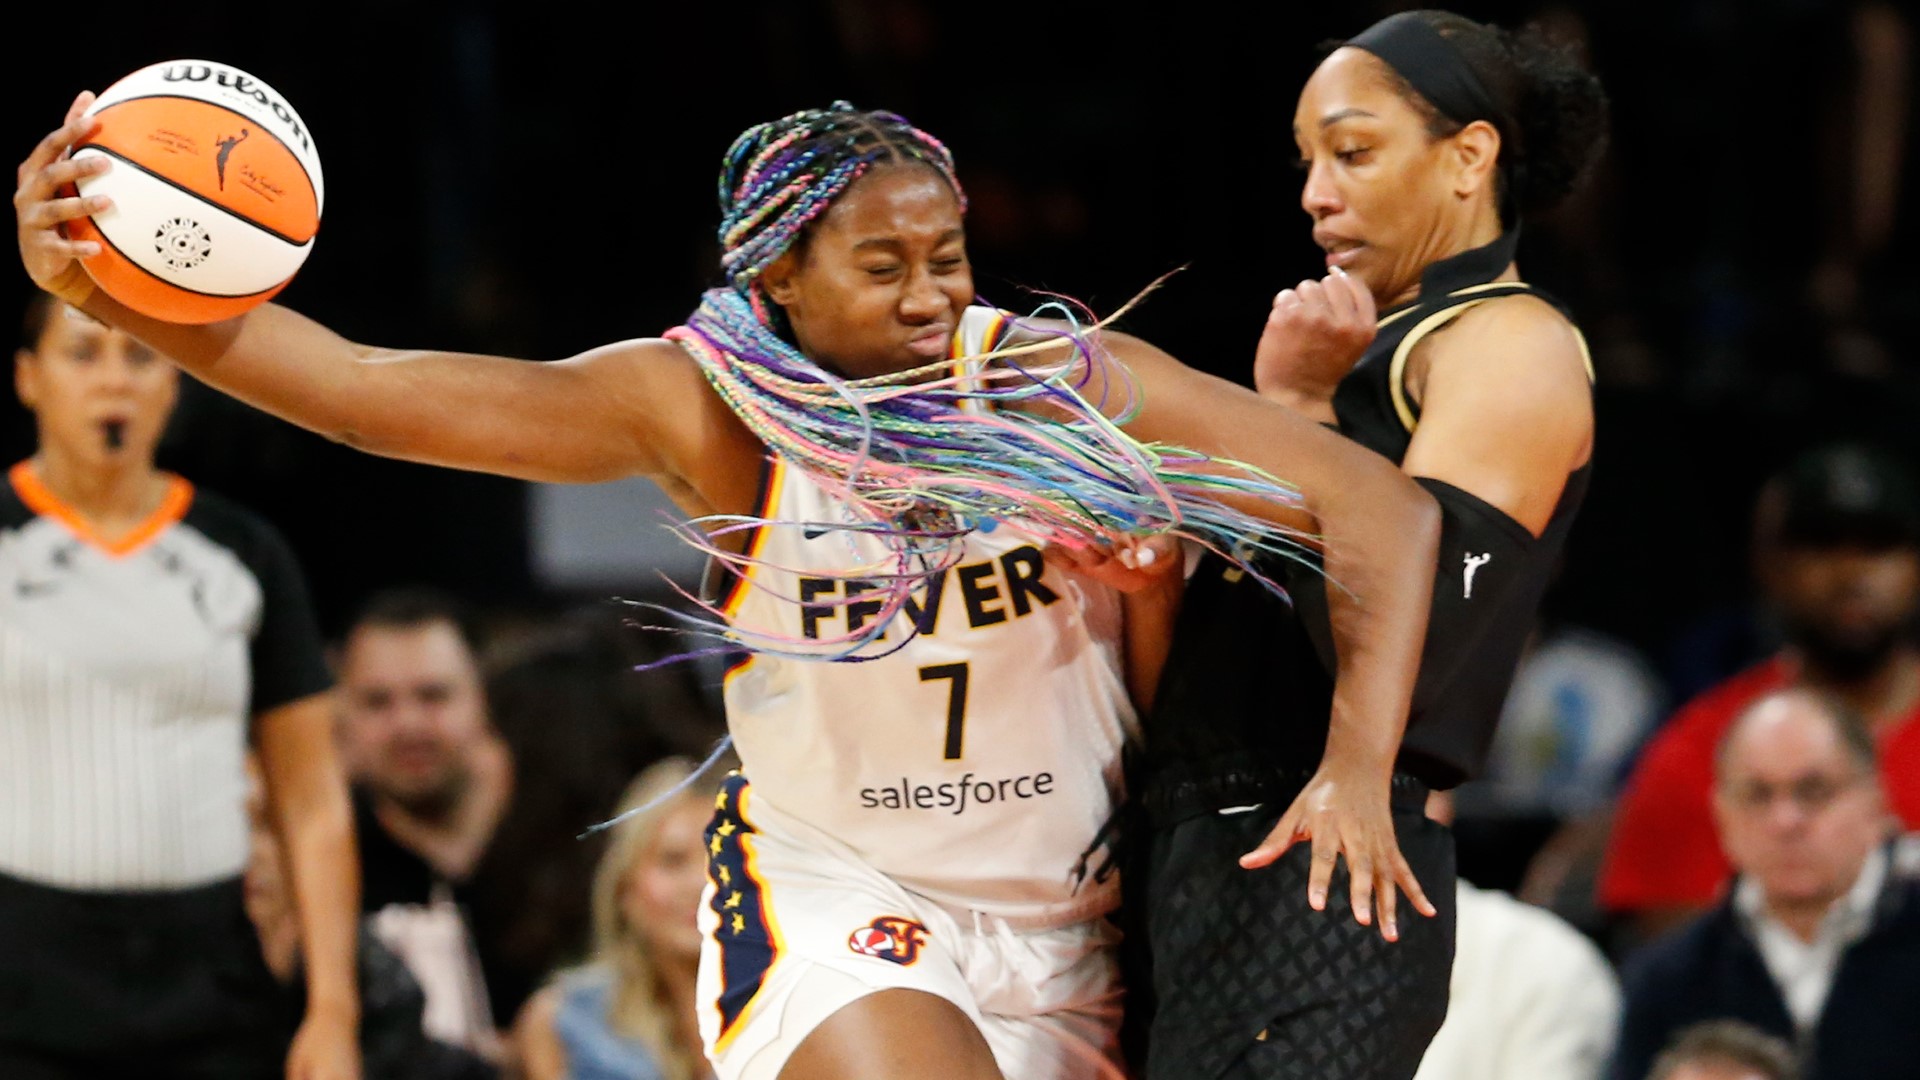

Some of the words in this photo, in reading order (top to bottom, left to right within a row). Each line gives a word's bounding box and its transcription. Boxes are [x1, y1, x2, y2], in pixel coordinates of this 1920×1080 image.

[162, 65, 309, 155] Wilson
[799, 544, 1060, 640] FEVER
[917, 661, 969, 760] 7
[860, 771, 1054, 815] salesforce
